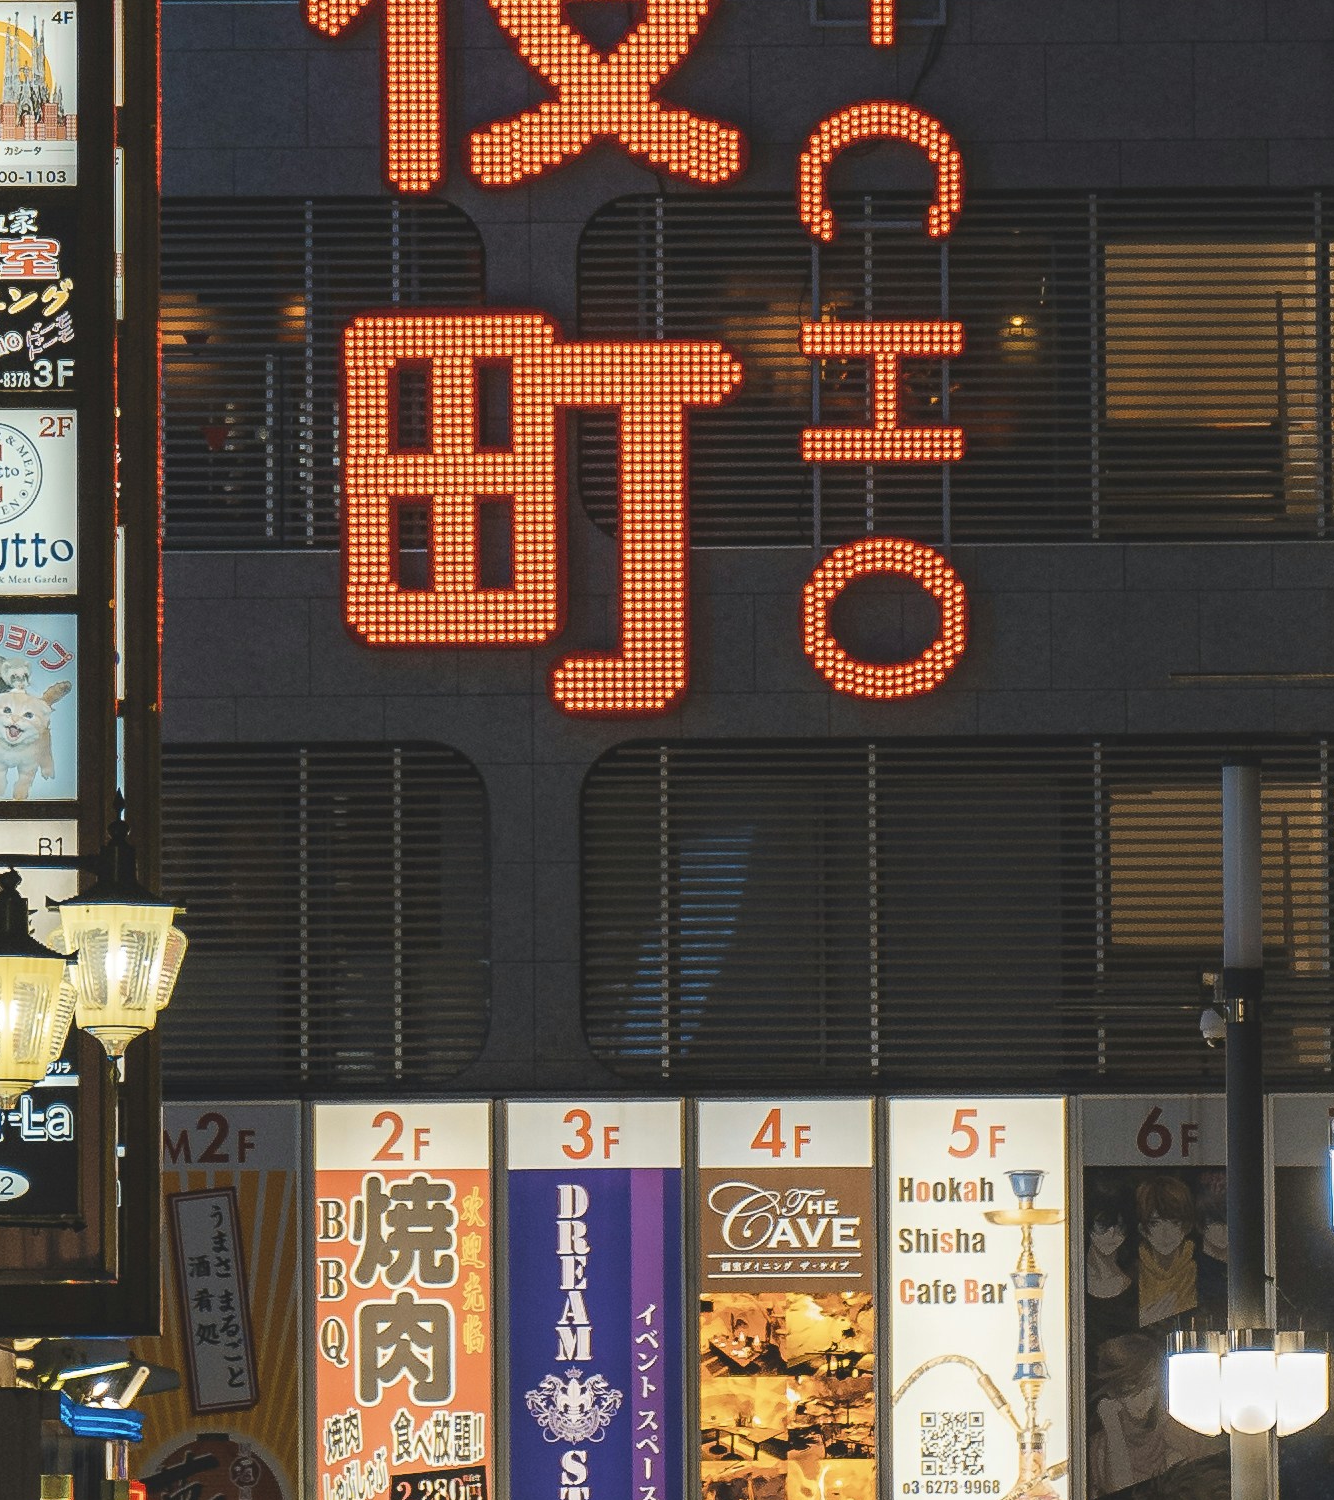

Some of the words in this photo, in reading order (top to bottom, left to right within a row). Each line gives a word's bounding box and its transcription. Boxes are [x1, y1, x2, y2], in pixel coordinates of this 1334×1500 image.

[51, 10, 74, 24] 4F
[34, 359, 75, 388] 3F
[39, 416, 73, 438] 2F
[8, 575, 33, 585] Meat
[34, 575, 69, 585] Garden
[561, 1108, 620, 1160] 3F
[750, 1108, 812, 1158] 4F
[948, 1108, 1007, 1159] 5F
[782, 1188, 839, 1216] THE
[899, 1176, 995, 1203] Hookah
[899, 1228, 986, 1254] Shisha
[319, 1199, 347, 1368] BBQ
[556, 1184, 593, 1362] DREAM
[353, 1173, 455, 1405] 焼肉
[899, 1278, 956, 1305] Cafe
[964, 1278, 1007, 1305] Bar
